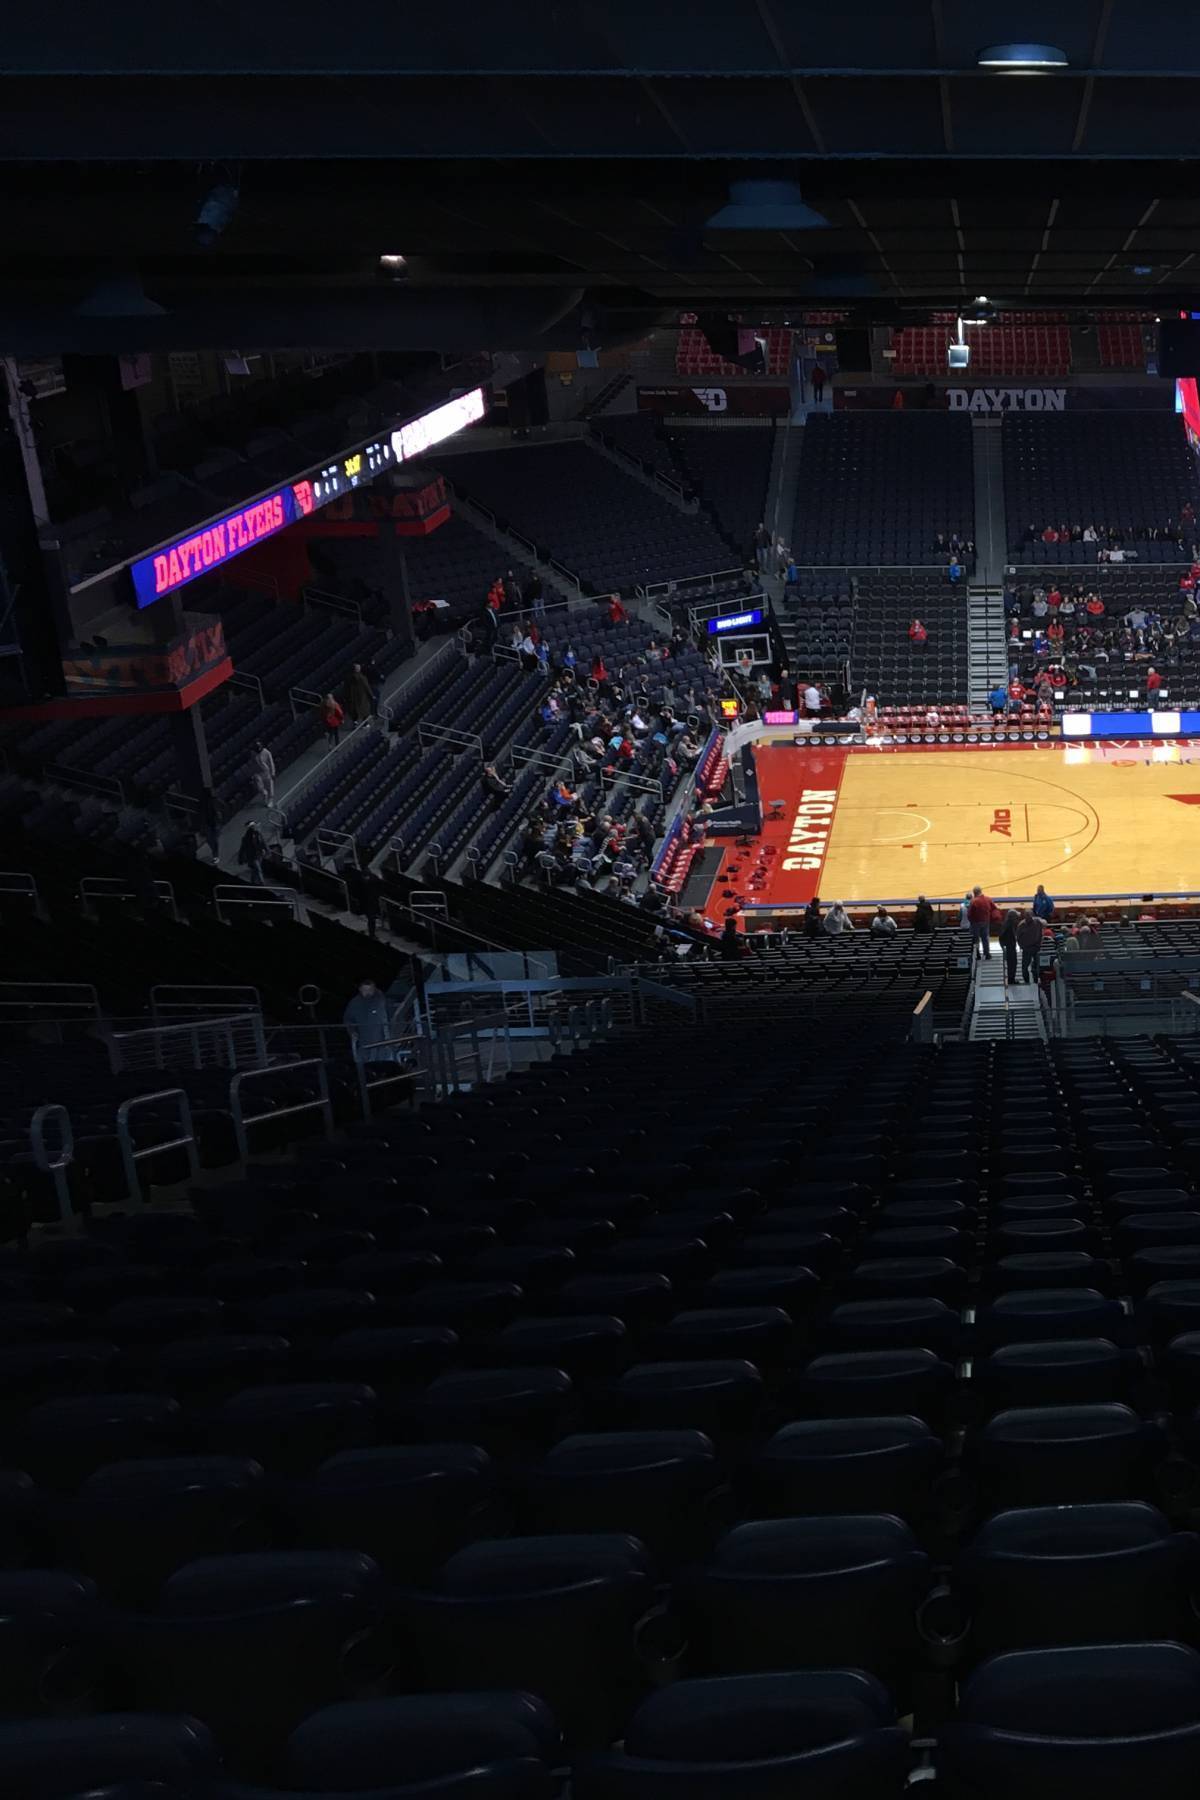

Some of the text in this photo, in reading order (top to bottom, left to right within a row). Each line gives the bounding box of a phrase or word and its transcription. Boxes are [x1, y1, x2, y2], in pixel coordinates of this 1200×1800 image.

[945, 389, 1067, 411] DAYTON
[153, 495, 283, 593] DAYTON FLYERS
[782, 789, 838, 871] DAYTON
